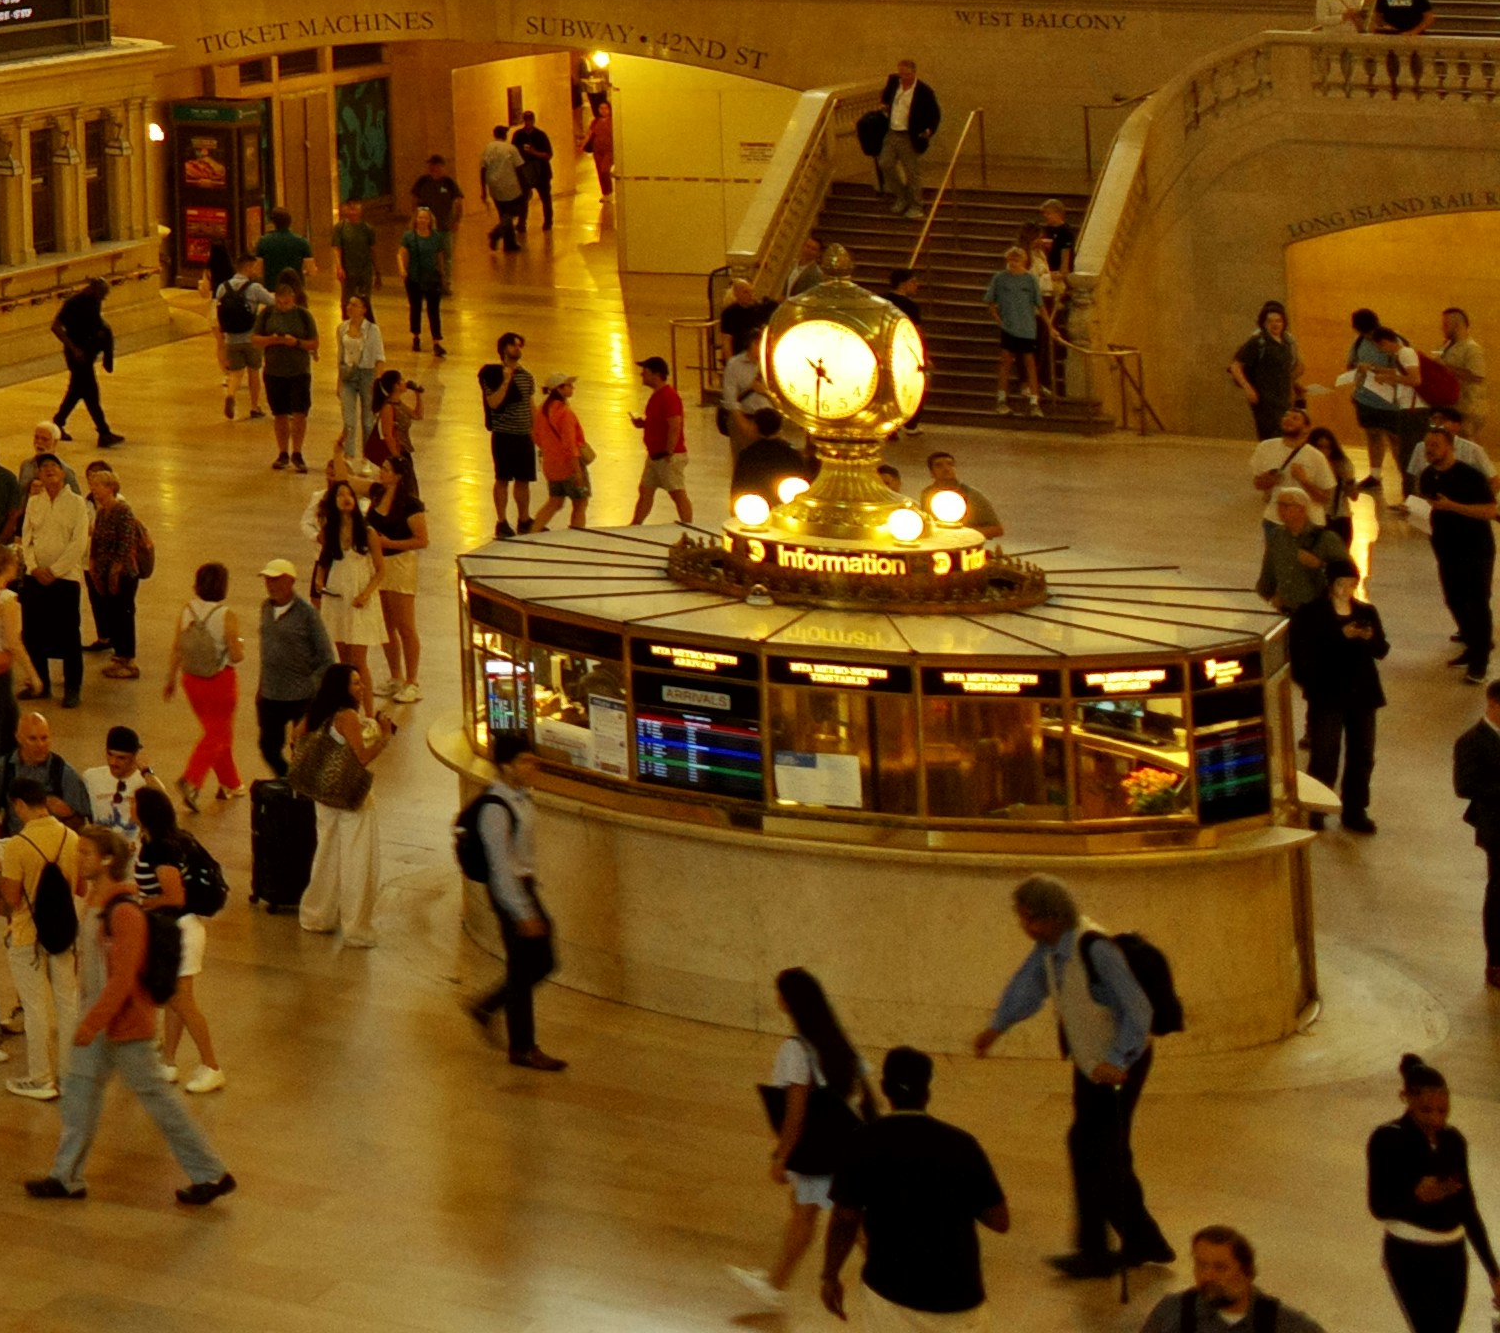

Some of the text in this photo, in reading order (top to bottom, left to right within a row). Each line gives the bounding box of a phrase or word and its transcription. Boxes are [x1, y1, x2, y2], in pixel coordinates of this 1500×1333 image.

[197, 11, 435, 55] TICKET MACHINES
[955, 10, 1127, 31] WEST BALCONY
[526, 15, 770, 70] SUBWAY 42ND ST
[1287, 211, 1346, 239] LONG
[1349, 196, 1426, 222] ISLAND
[1429, 191, 1479, 211] RAIL
[776, 544, 906, 576] Information
[666, 688, 728, 708] ARRIVALS
